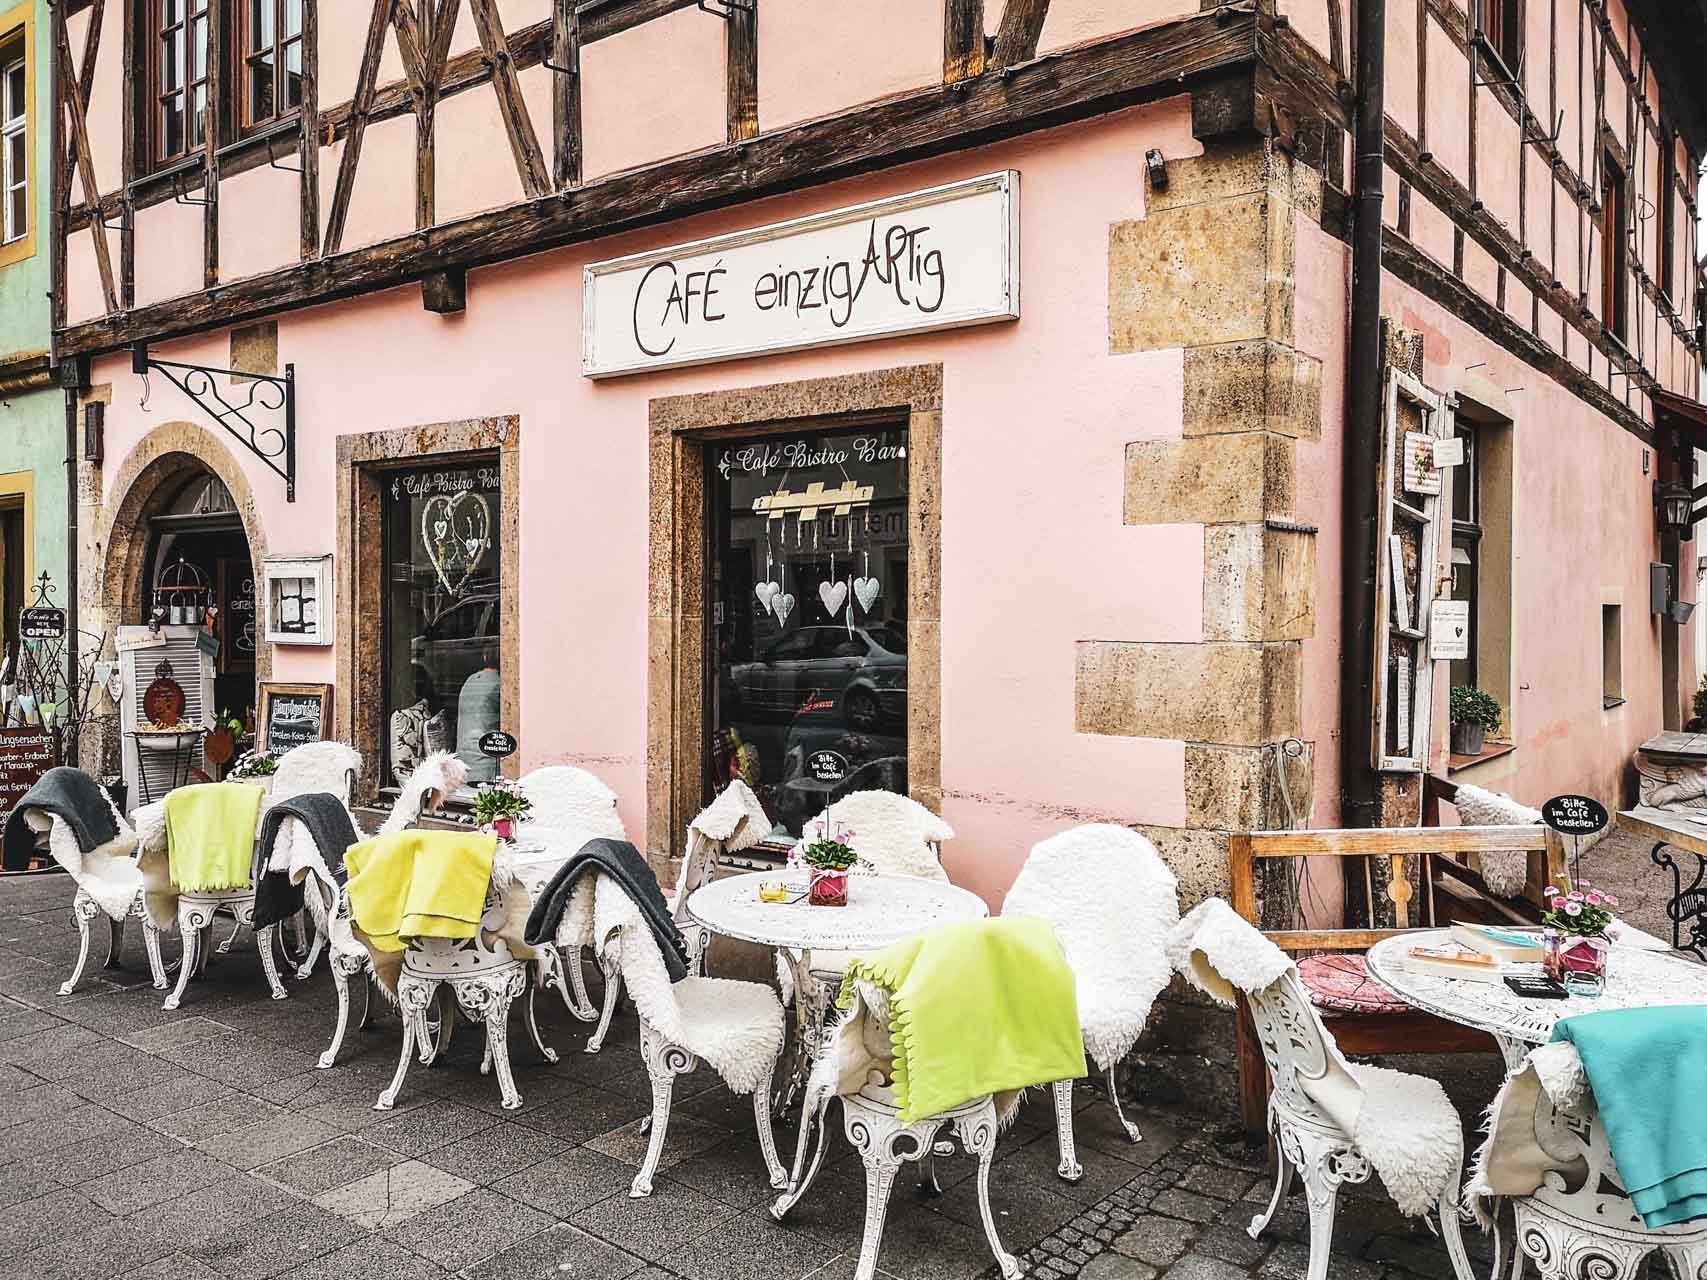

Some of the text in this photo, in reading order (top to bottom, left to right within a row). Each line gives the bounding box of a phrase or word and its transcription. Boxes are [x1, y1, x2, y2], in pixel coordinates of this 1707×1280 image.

[633, 218, 945, 356] CAFÉ einzigARTig
[736, 437, 899, 478] Café Bistro Bar
[403, 474, 432, 500] Café
[434, 472, 474, 493] Bistro
[26, 628, 60, 637] OPEN
[1552, 808, 1564, 816] im
[1560, 799, 1589, 810] Bitte
